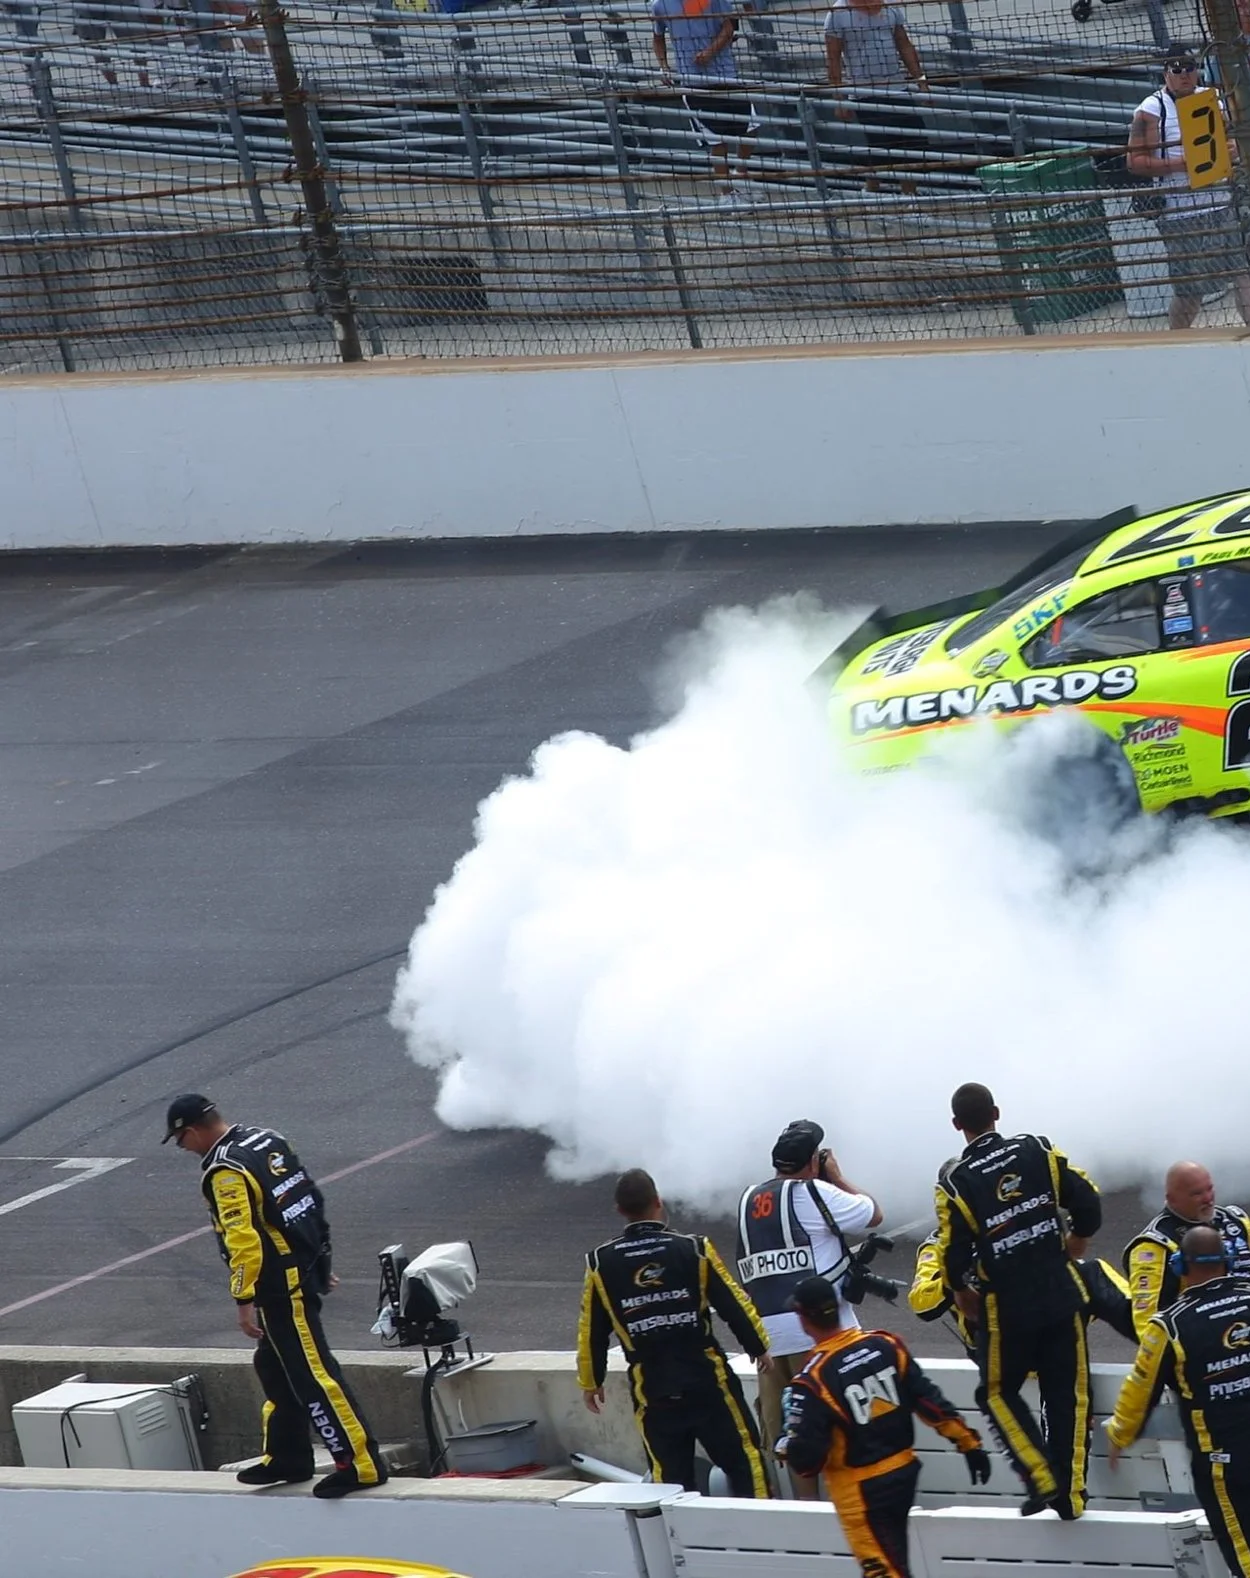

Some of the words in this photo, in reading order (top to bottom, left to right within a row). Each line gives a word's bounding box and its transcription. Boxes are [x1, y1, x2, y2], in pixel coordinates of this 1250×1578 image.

[1191, 106, 1217, 173] 3
[1013, 588, 1071, 640] SKF
[853, 666, 1136, 733] MENARDS
[1128, 720, 1180, 744] Turtle
[1153, 763, 1189, 776] MOEN
[752, 1191, 774, 1219] 36
[985, 1194, 1050, 1228] MENARDS
[757, 1249, 809, 1274] PHOTO
[620, 1287, 690, 1309] MENARDS
[627, 1310, 698, 1334] PITTSBURGH
[844, 1365, 901, 1426] CAT
[308, 1401, 344, 1453] MOEN
